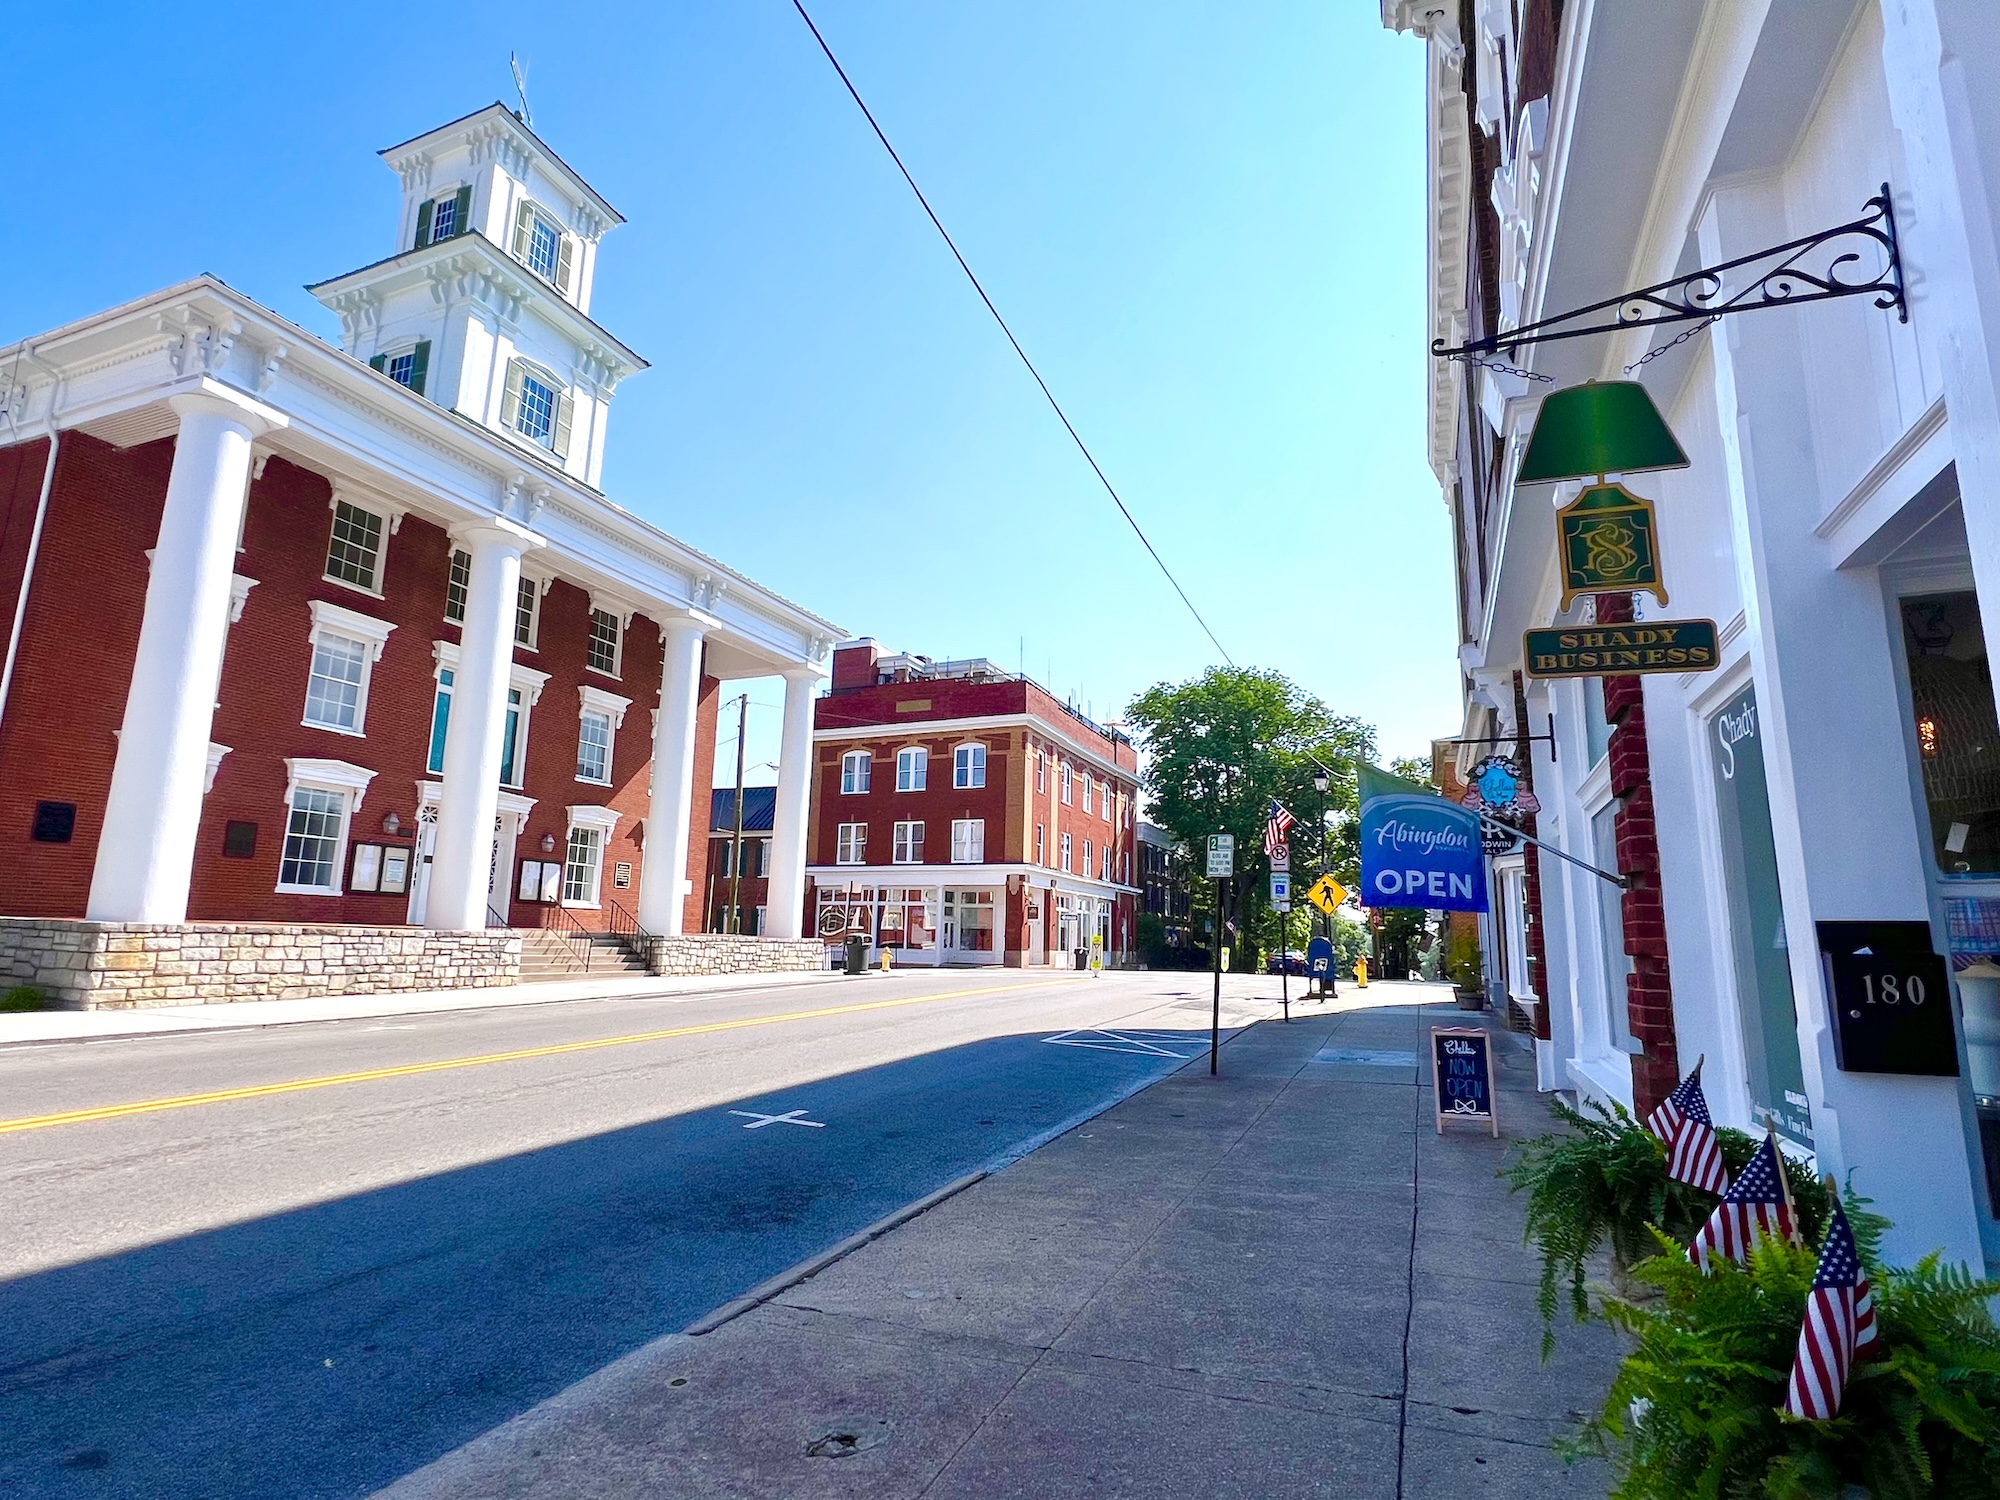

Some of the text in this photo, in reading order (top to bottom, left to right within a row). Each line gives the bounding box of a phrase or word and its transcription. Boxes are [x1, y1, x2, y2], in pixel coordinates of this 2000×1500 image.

[1559, 628, 1679, 648] SHADY
[1534, 646, 1711, 671] BUSINESS
[1718, 702, 1756, 780] Shady
[1210, 838, 1217, 850] 2
[1372, 819, 1468, 856] Abingdon
[1480, 840, 1513, 849] ODWIN
[1375, 869, 1473, 900] OPEN
[1863, 974, 1926, 1005] 180
[1449, 1058, 1475, 1076] NOW
[1447, 1077, 1482, 1099] OPEN
